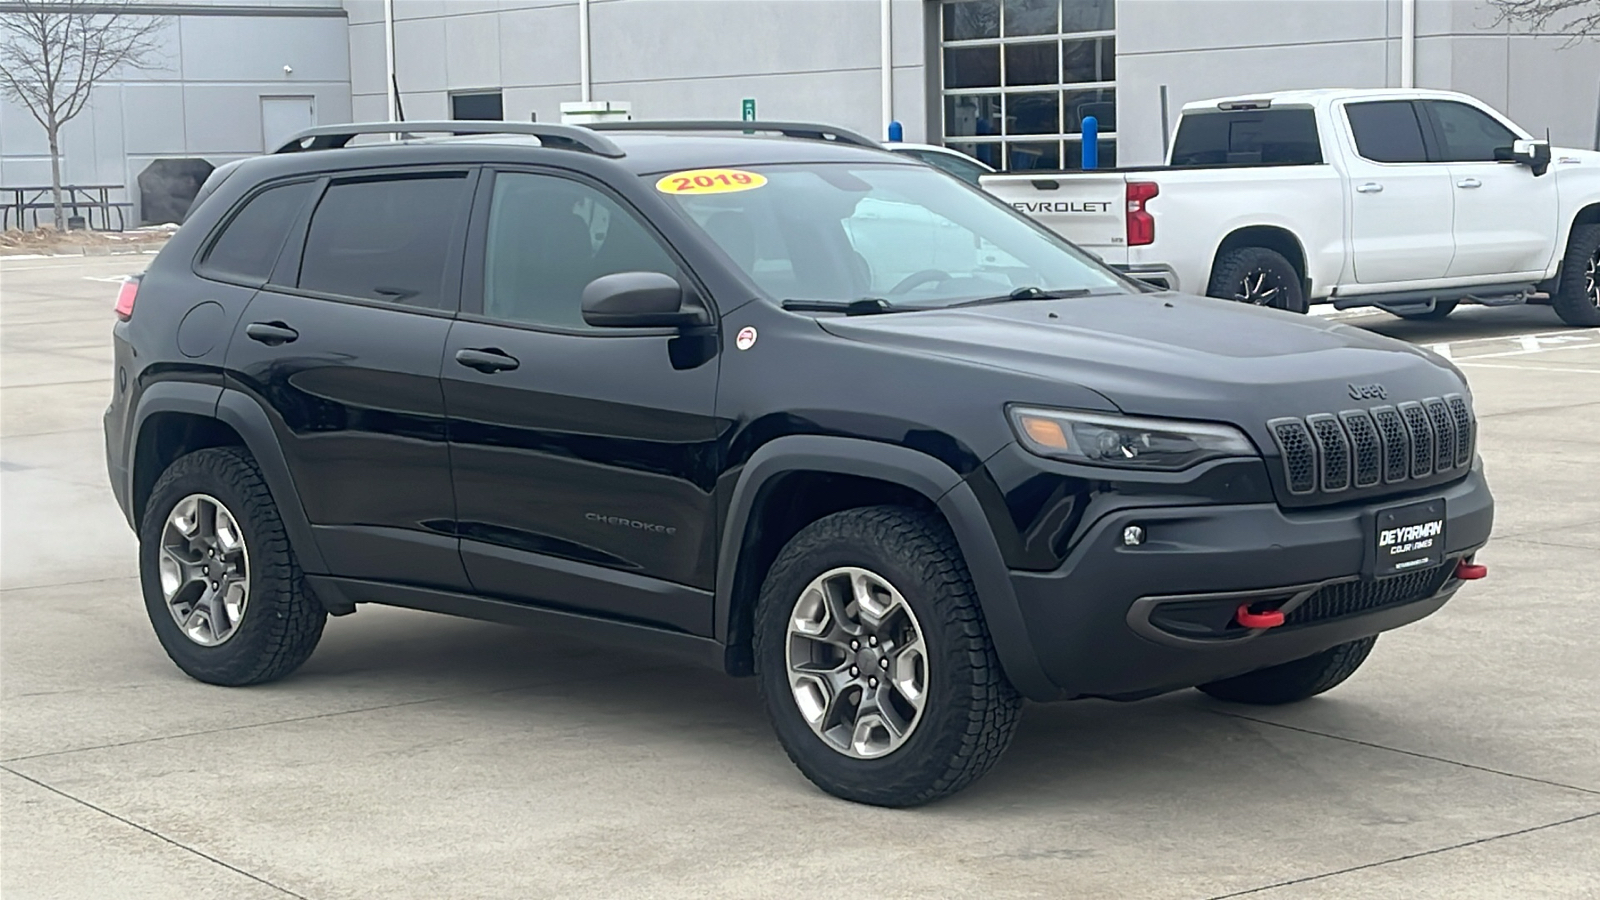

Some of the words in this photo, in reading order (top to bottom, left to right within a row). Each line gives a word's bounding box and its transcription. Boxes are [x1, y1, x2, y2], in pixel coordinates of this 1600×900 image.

[672, 173, 752, 191] 2019
[1009, 201, 1112, 212] EVROLET
[1347, 383, 1388, 401] Jeep
[585, 512, 676, 535] CHEROKEE
[1379, 520, 1443, 546] DEYARMAN
